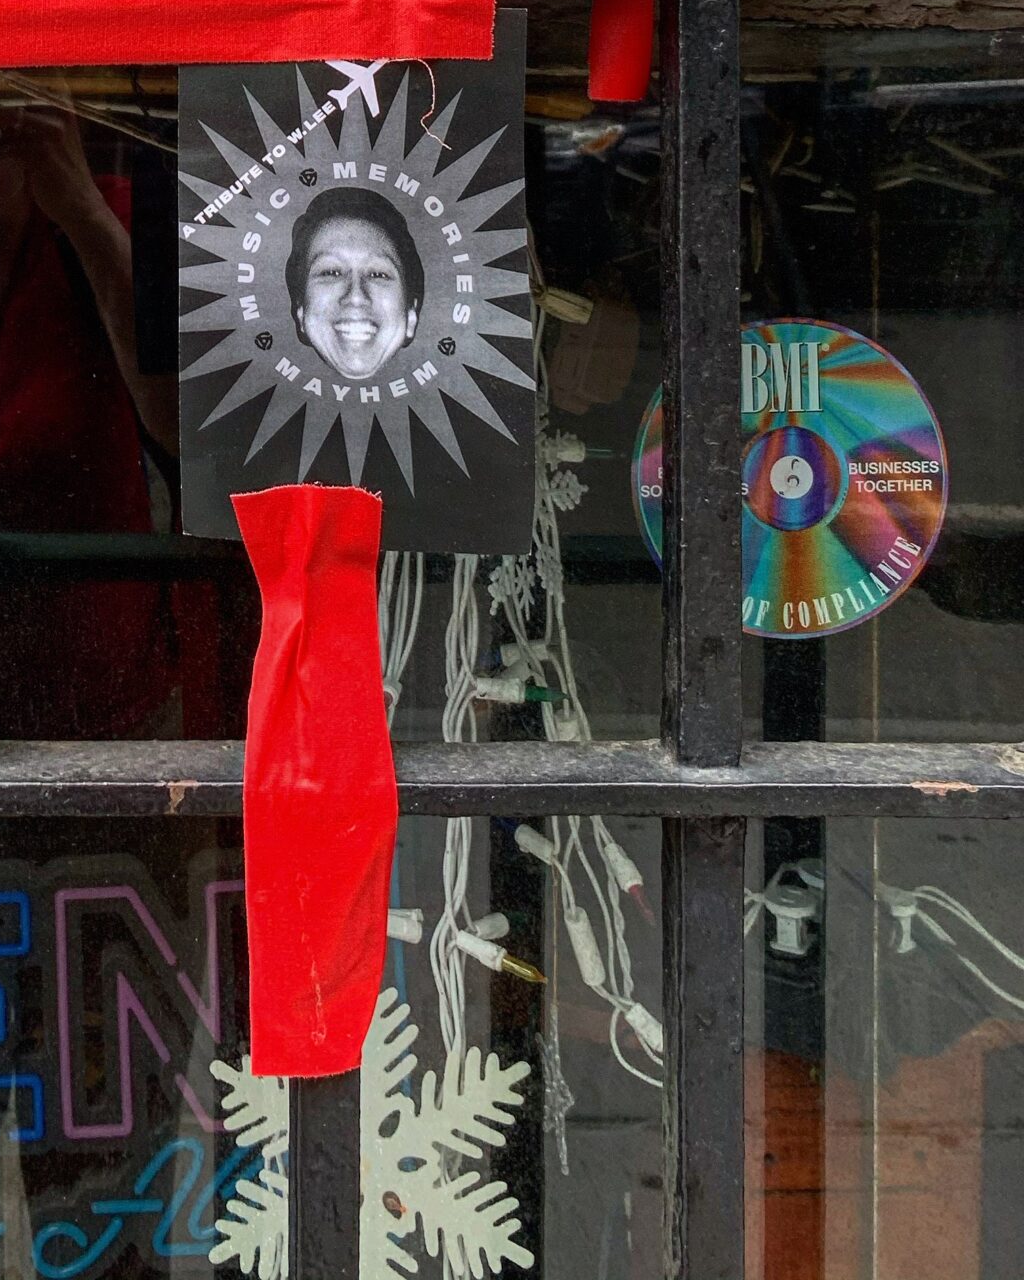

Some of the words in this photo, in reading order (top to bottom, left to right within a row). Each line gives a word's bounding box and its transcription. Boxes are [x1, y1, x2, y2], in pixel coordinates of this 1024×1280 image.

[182, 224, 196, 239] A
[193, 164, 263, 225] TRIBUTE
[261, 144, 286, 166] TO
[237, 187, 291, 322] MUSIC
[332, 161, 474, 325] MEMORIES
[274, 356, 439, 403] MAYHEM
[741, 341, 824, 413] BMI
[848, 460, 940, 475] BUSINESSES
[855, 479, 933, 493] TOGETHER
[782, 535, 923, 630] COMPLIANCE
